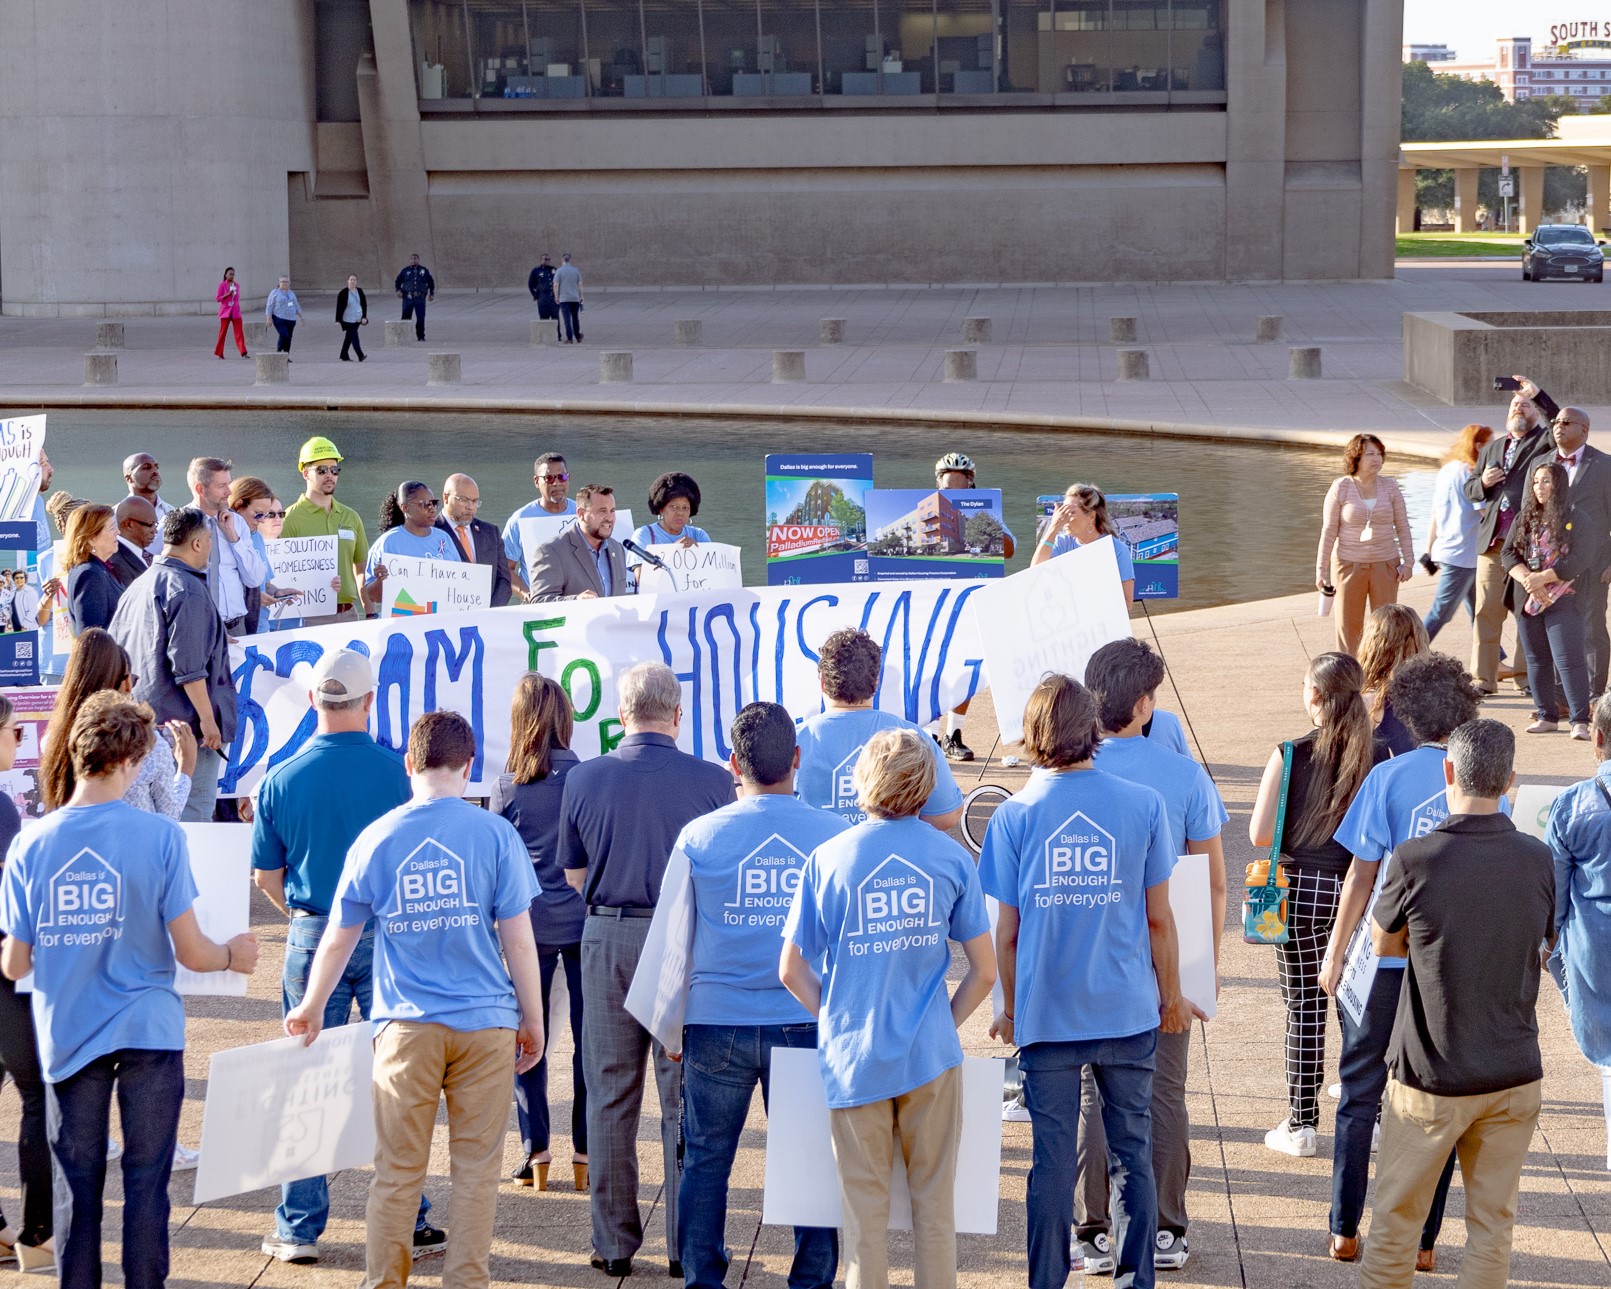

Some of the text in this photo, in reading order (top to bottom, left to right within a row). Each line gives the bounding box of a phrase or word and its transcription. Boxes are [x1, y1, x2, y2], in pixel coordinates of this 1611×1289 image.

[1551, 22, 1611, 46] SOUTH S
[0, 421, 32, 446] S is
[2, 441, 31, 461] OUGH
[0, 532, 20, 540] eryone.
[772, 526, 815, 542] NOW
[265, 538, 333, 555] THE SOLUTION
[274, 558, 335, 573] HOMELESSNESS
[389, 558, 408, 578] Can
[431, 562, 456, 580] have
[462, 572, 470, 581] a
[702, 551, 736, 573] Million
[681, 573, 707, 592] for
[447, 587, 482, 605] House
[1061, 833, 1099, 844] Dallas is
[410, 857, 449, 871] Dallas is
[755, 855, 796, 866] Dallas is
[1053, 846, 1108, 872] BIG
[65, 870, 105, 881] Dallas is
[745, 867, 802, 894] BIG
[873, 874, 917, 889] Dallas is
[1052, 875, 1107, 886] ENOUGH
[402, 869, 459, 900] BIG
[57, 882, 115, 911] BIG
[744, 896, 794, 908] ENOUG
[865, 887, 926, 919] BIG
[1034, 891, 1121, 909] for everyone
[406, 897, 460, 914] ENOUGH
[388, 913, 480, 934] for everyone
[723, 910, 746, 925] for
[867, 917, 925, 934] ENOUGH
[39, 931, 61, 947] for
[848, 932, 939, 956] for everyone
